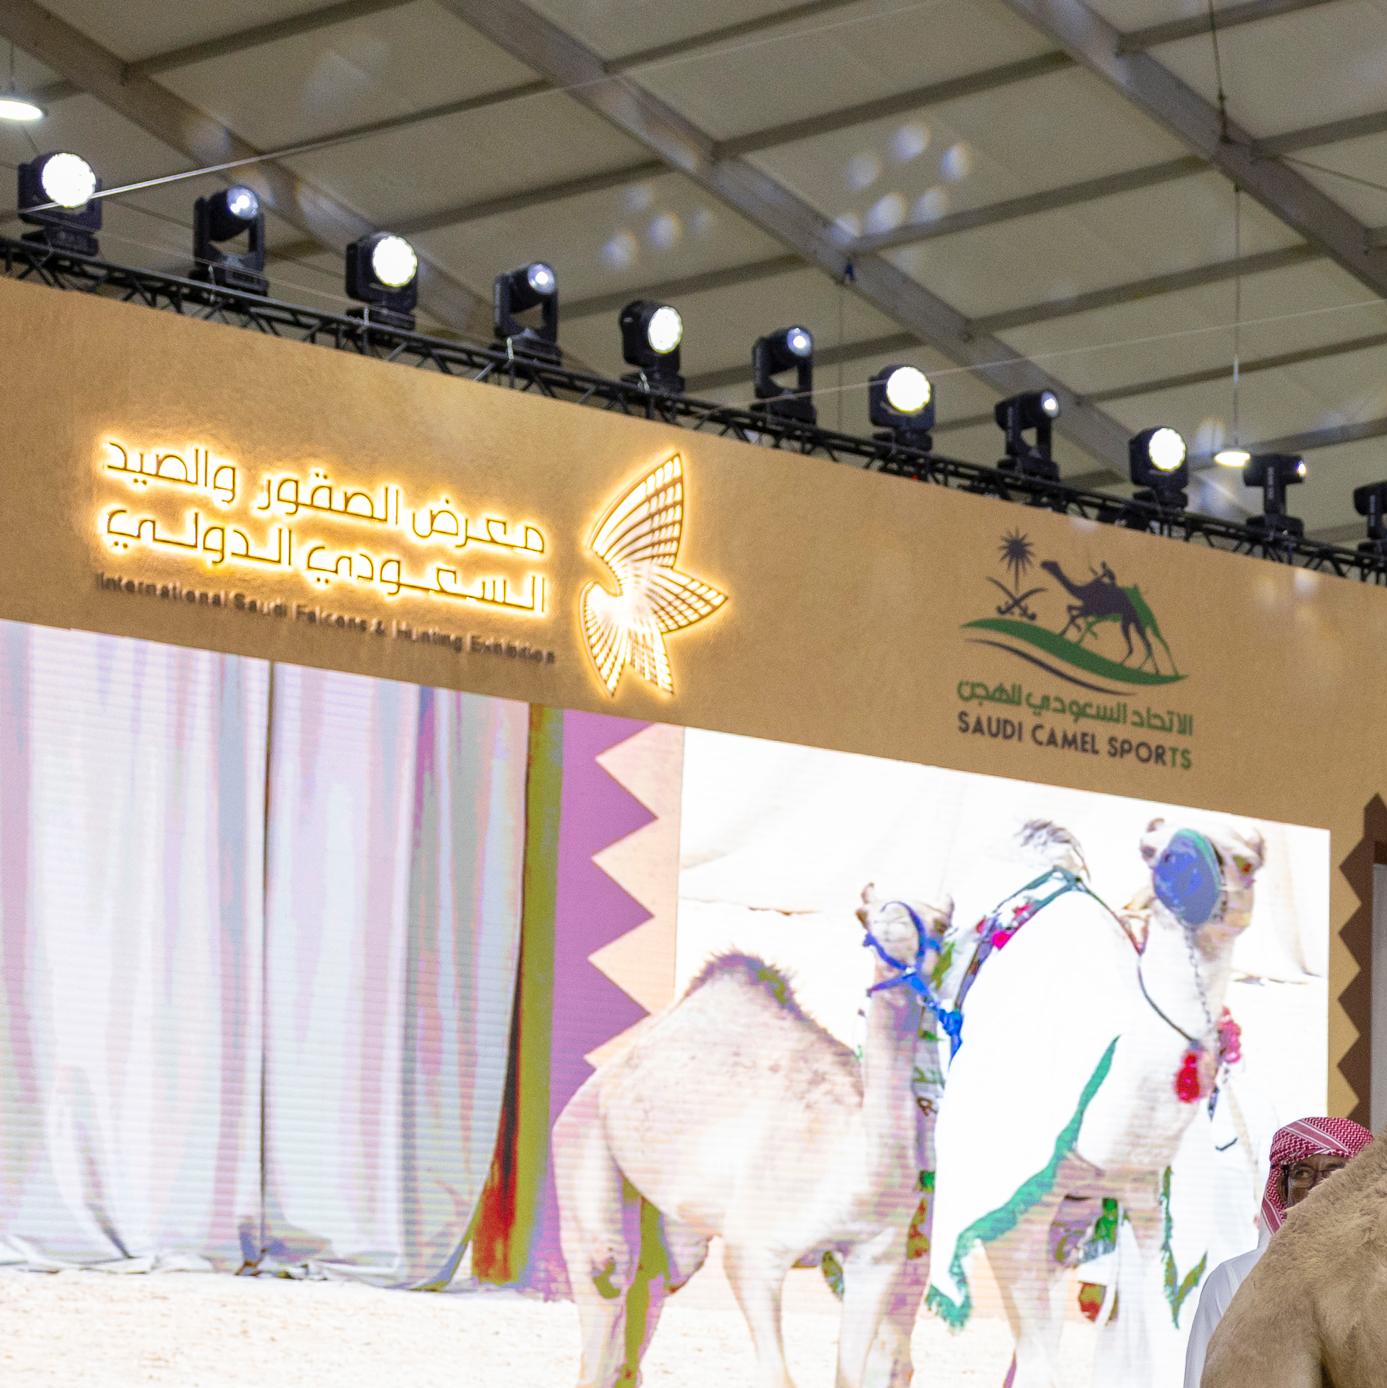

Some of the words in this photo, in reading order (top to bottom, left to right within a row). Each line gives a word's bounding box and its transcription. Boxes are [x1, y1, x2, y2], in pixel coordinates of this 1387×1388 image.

[104, 440, 238, 503] والصيد
[257, 470, 399, 531] الصقور
[105, 507, 293, 566] الدولي
[411, 498, 546, 554] معرض
[306, 543, 546, 613] السعودي
[957, 679, 1022, 706] للهجن
[1026, 690, 1128, 724] السعودي
[1131, 705, 1194, 737] الاتحاد
[957, 710, 1024, 742] SAUDI
[1031, 723, 1099, 756] CAMEL
[1107, 736, 1193, 770] SPORTS
